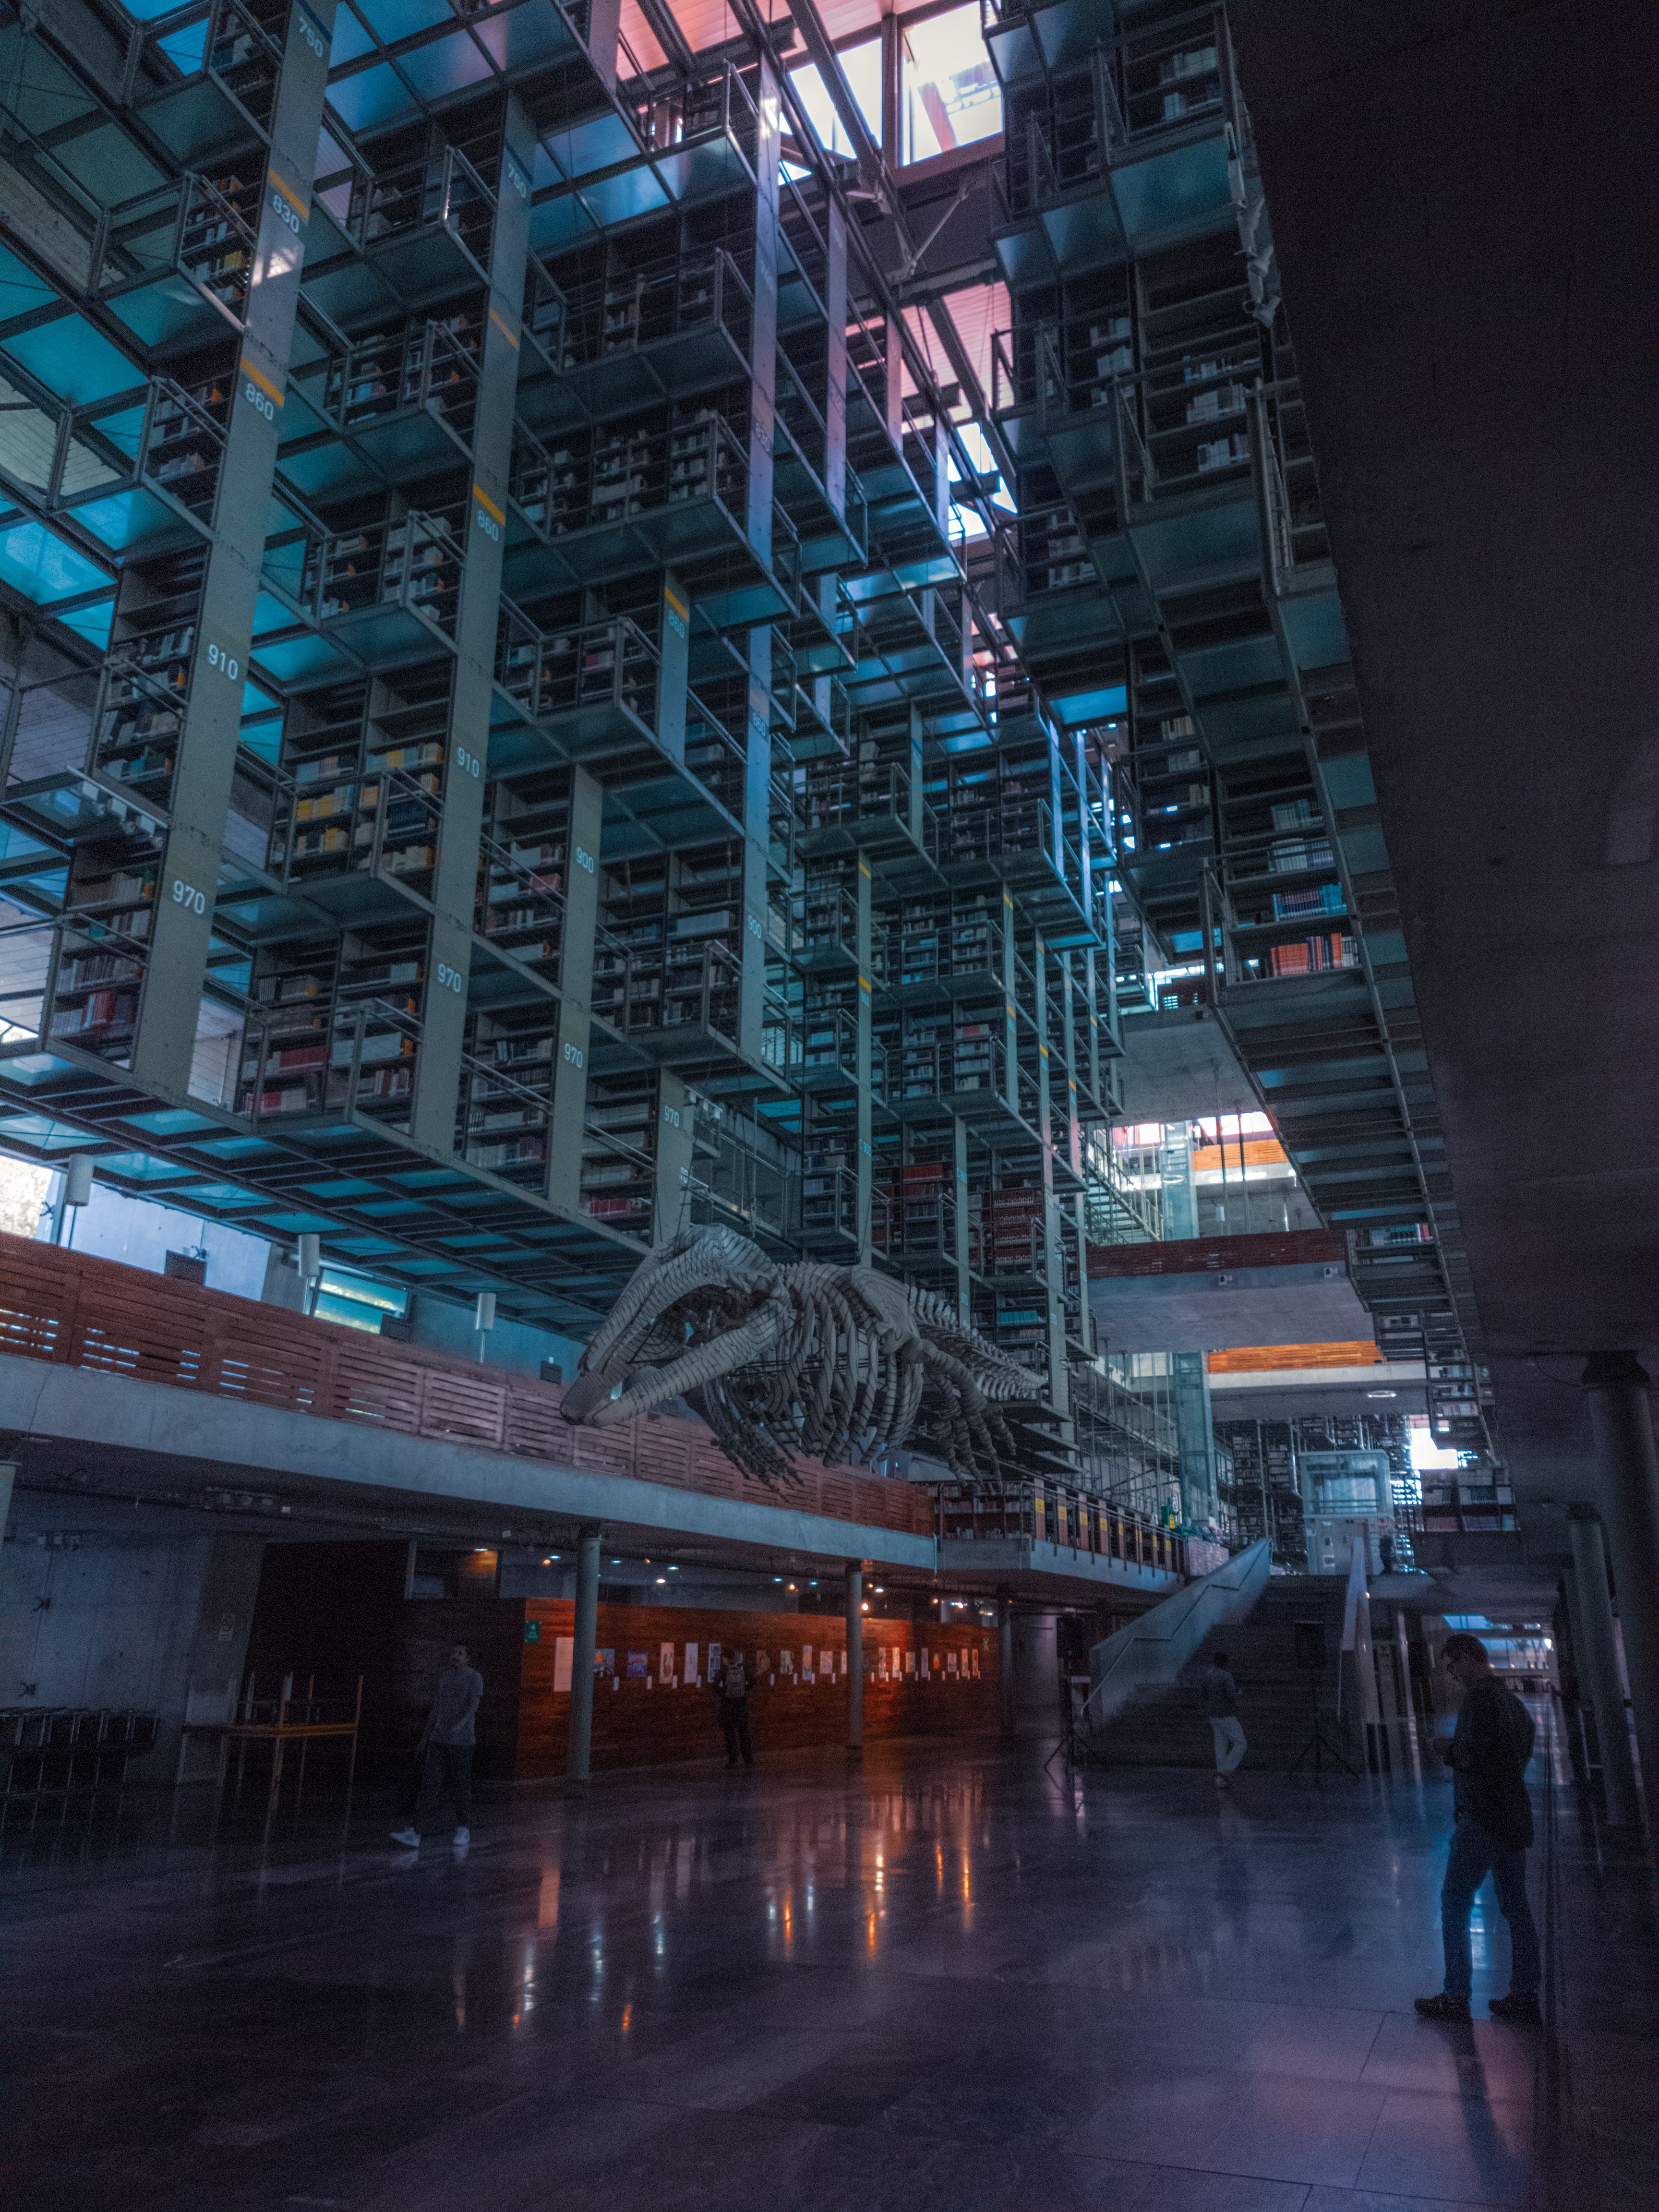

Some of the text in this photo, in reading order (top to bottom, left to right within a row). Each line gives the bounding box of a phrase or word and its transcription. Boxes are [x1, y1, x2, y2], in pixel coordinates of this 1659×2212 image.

[299, 16, 323, 57] 750
[507, 162, 527, 198] 750
[272, 194, 300, 233] 830
[245, 383, 274, 421] 860
[478, 509, 498, 541] 860
[669, 609, 685, 638] 860
[207, 644, 239, 680] 910
[753, 711, 766, 736] 860
[457, 747, 480, 778] 910
[576, 846, 594, 874] 900
[172, 880, 205, 914] 970
[748, 914, 761, 939] 900
[438, 963, 462, 993] 970
[564, 1043, 583, 1068] 970
[664, 1105, 680, 1127] 970
